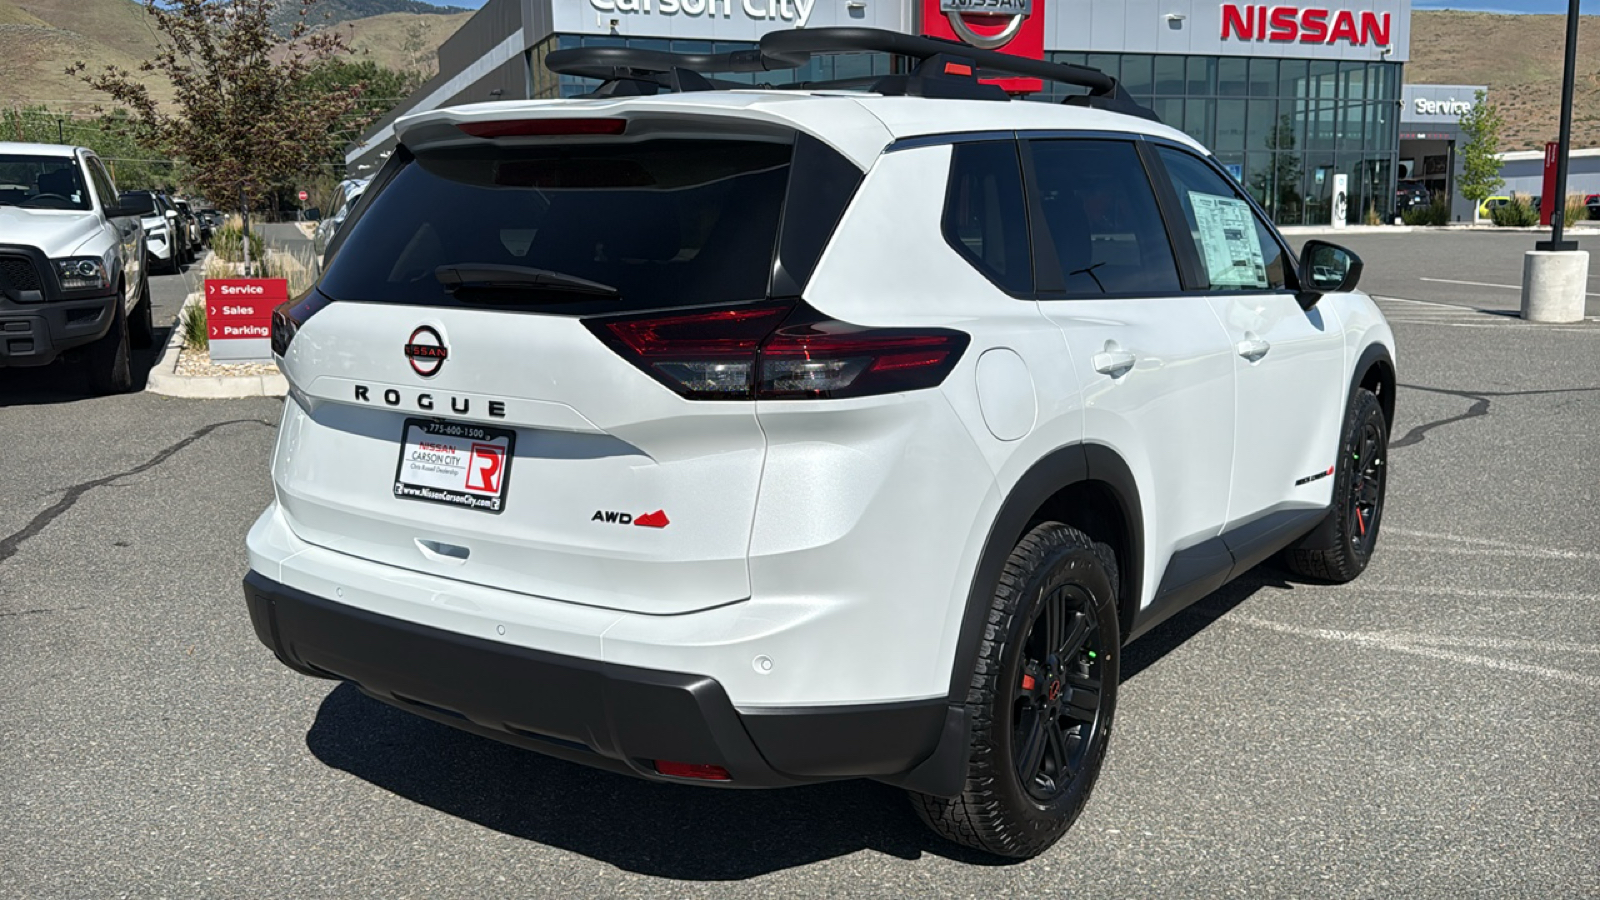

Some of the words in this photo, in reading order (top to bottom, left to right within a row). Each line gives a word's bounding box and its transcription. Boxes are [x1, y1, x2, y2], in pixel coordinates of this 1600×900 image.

[1221, 5, 1390, 46] NISSAN
[1414, 97, 1470, 114] Service
[220, 285, 264, 295] Service
[222, 305, 254, 315] Sales
[224, 325, 269, 336] Parking
[355, 385, 506, 417] ROGUE
[429, 424, 484, 438] 775-600-1500
[419, 441, 456, 454] NISSAN
[412, 451, 444, 463] CARSON
[444, 455, 461, 466] CITY
[403, 487, 491, 508] www.NissanCarsonCity.com
[591, 510, 632, 525] AWD
